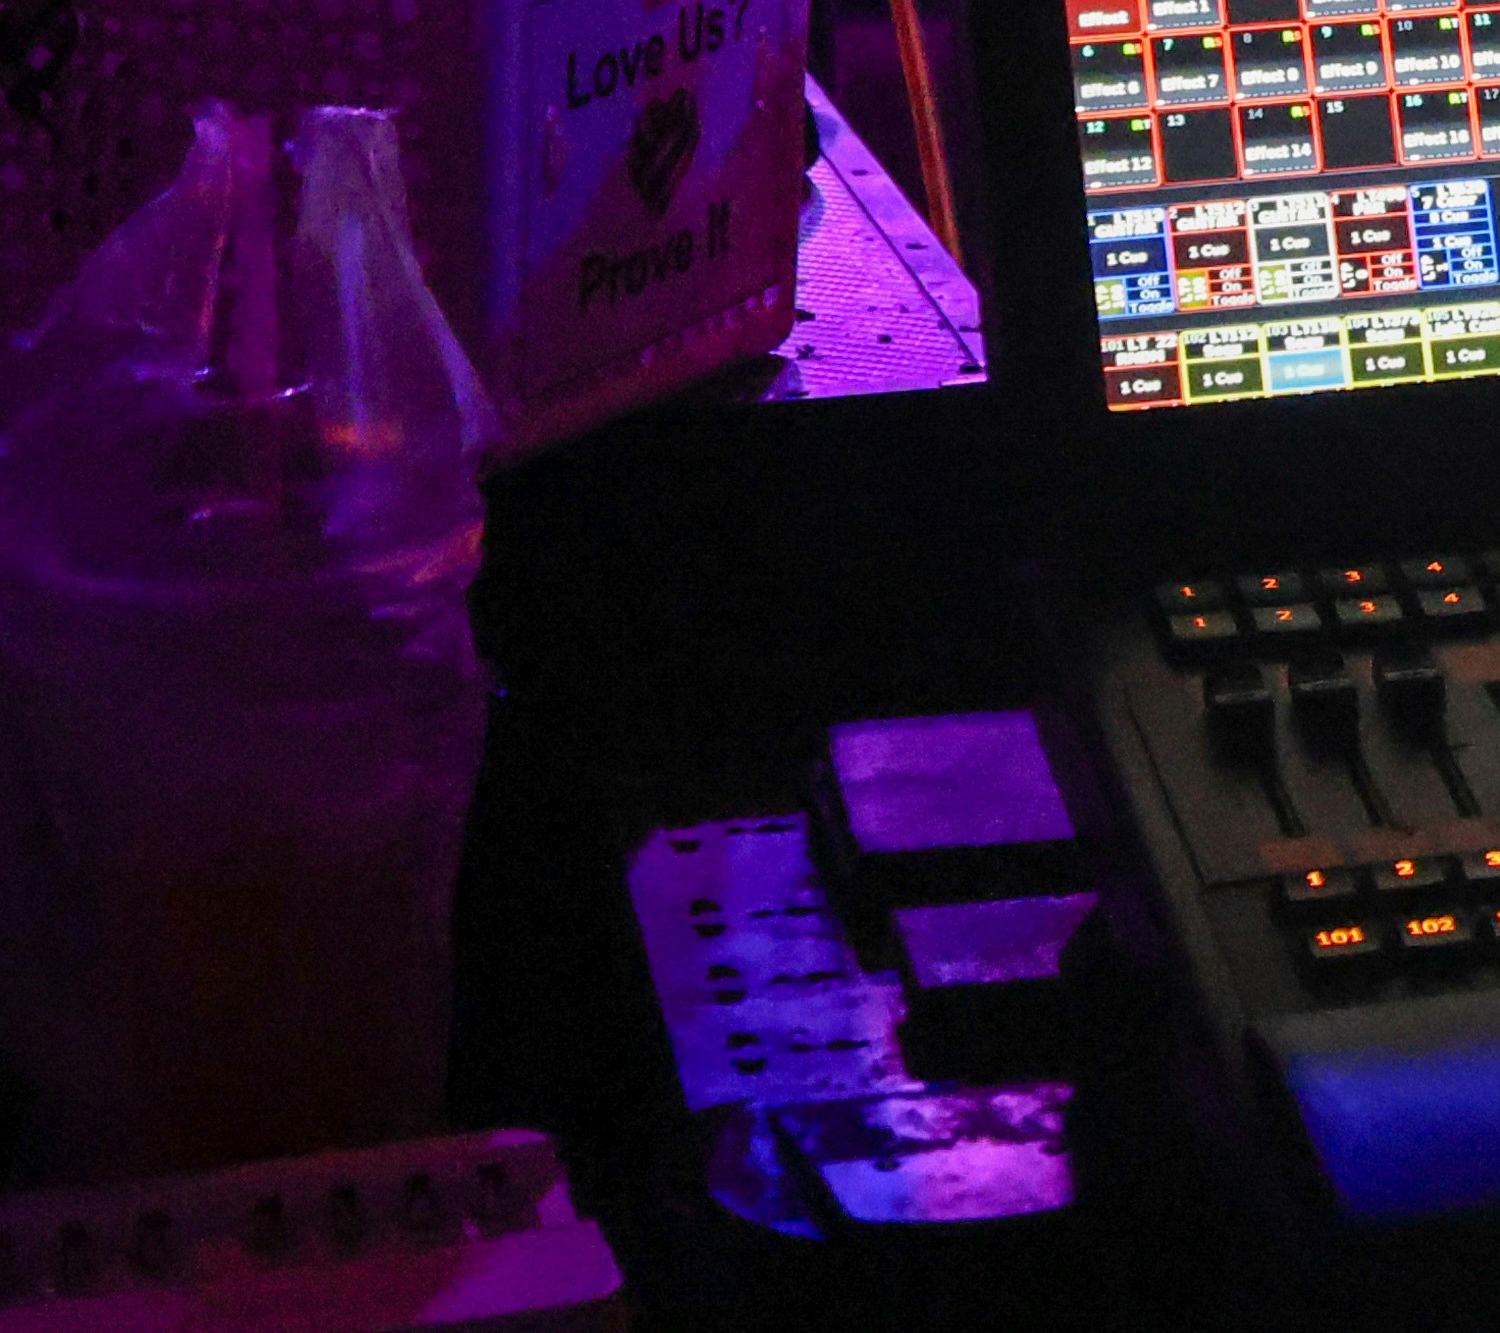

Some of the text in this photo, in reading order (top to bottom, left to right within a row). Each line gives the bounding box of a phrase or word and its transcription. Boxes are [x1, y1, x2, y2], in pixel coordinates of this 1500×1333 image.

[1078, 10, 1130, 28] Effect
[566, 34, 665, 110] Love
[1161, 74, 1219, 93] Effect 7
[1245, 143, 1311, 162] Effect 14
[706, 198, 731, 259] It
[1180, 586, 1195, 597] 1
[1263, 577, 1279, 589] 2
[1344, 570, 1361, 582] 3
[1426, 561, 1443, 572] 4
[1193, 617, 1207, 629] 1
[1277, 609, 1293, 621] 2
[1359, 600, 1377, 614] 3
[1443, 592, 1460, 604] 4
[1306, 870, 1325, 888] 1
[1394, 859, 1416, 878] 2
[1315, 926, 1365, 948] 101
[1407, 915, 1456, 938] 102
